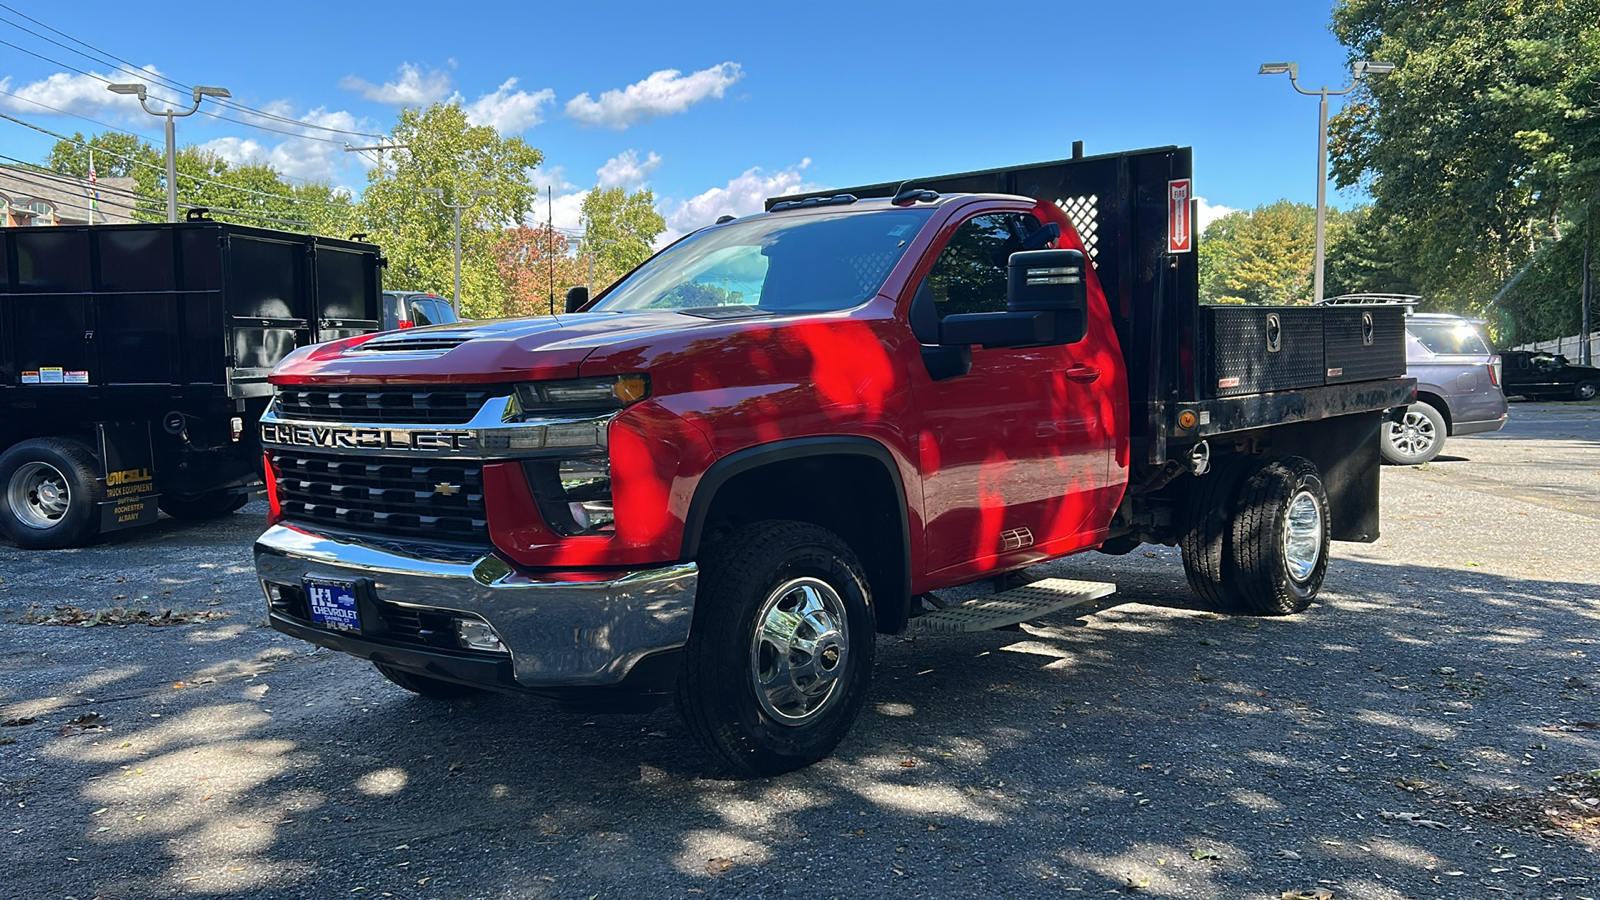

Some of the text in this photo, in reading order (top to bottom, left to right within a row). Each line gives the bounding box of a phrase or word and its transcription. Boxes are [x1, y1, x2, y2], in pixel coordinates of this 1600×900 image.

[1174, 190, 1185, 198] FIRE
[261, 424, 470, 452] CHEVROLET
[106, 483, 153, 498] TRUCK EQUIPMENT
[114, 503, 144, 514] ROCHESTER
[117, 513, 139, 523] ALBANY
[312, 606, 357, 619] CHEVROLET
